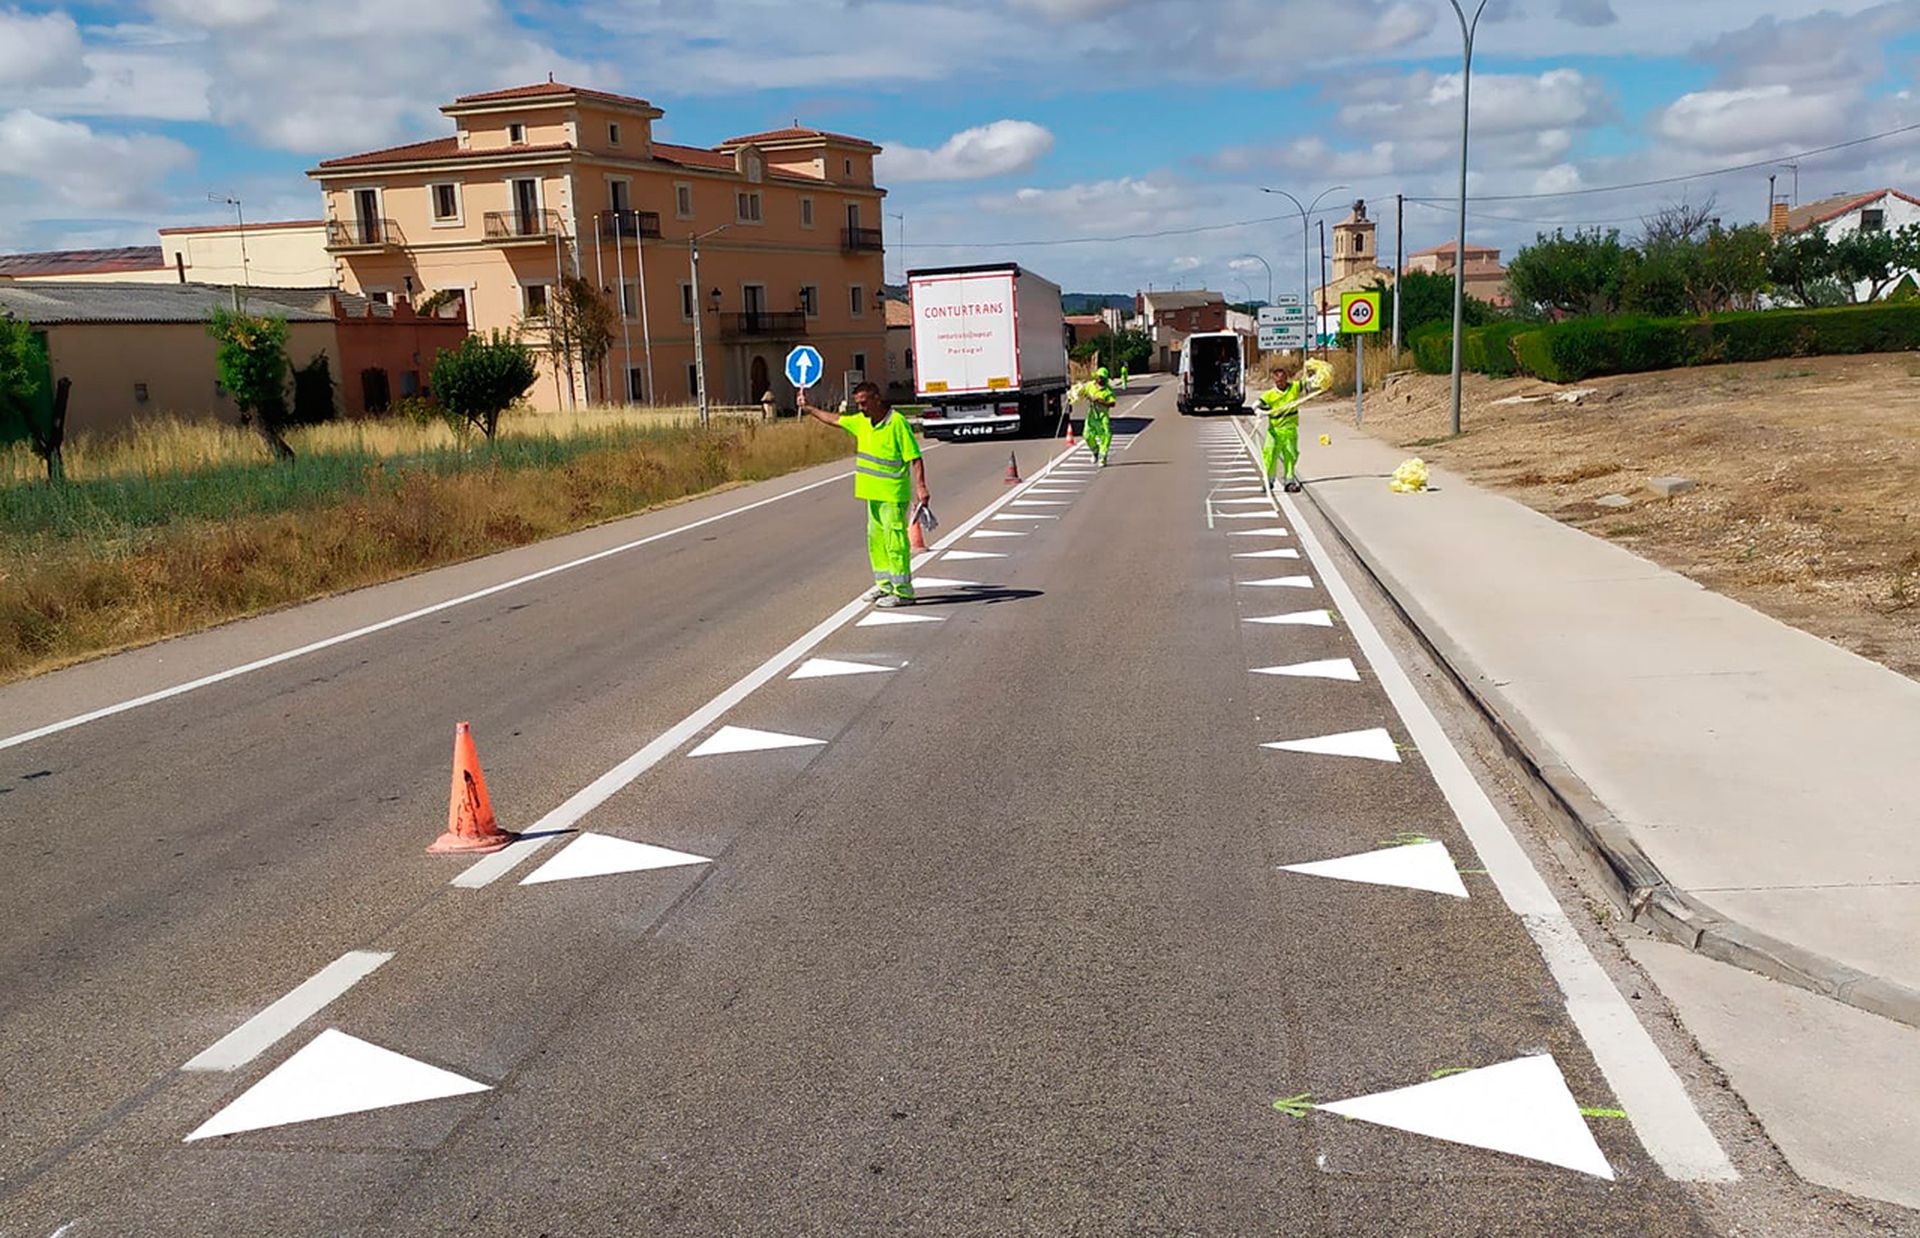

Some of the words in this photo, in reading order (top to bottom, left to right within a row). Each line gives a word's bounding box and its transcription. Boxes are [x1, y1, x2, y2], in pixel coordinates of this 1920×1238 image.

[924, 303, 1003, 318] CONTURTRANS
[1352, 307, 1369, 318] 40
[947, 346, 983, 354] Portugal
